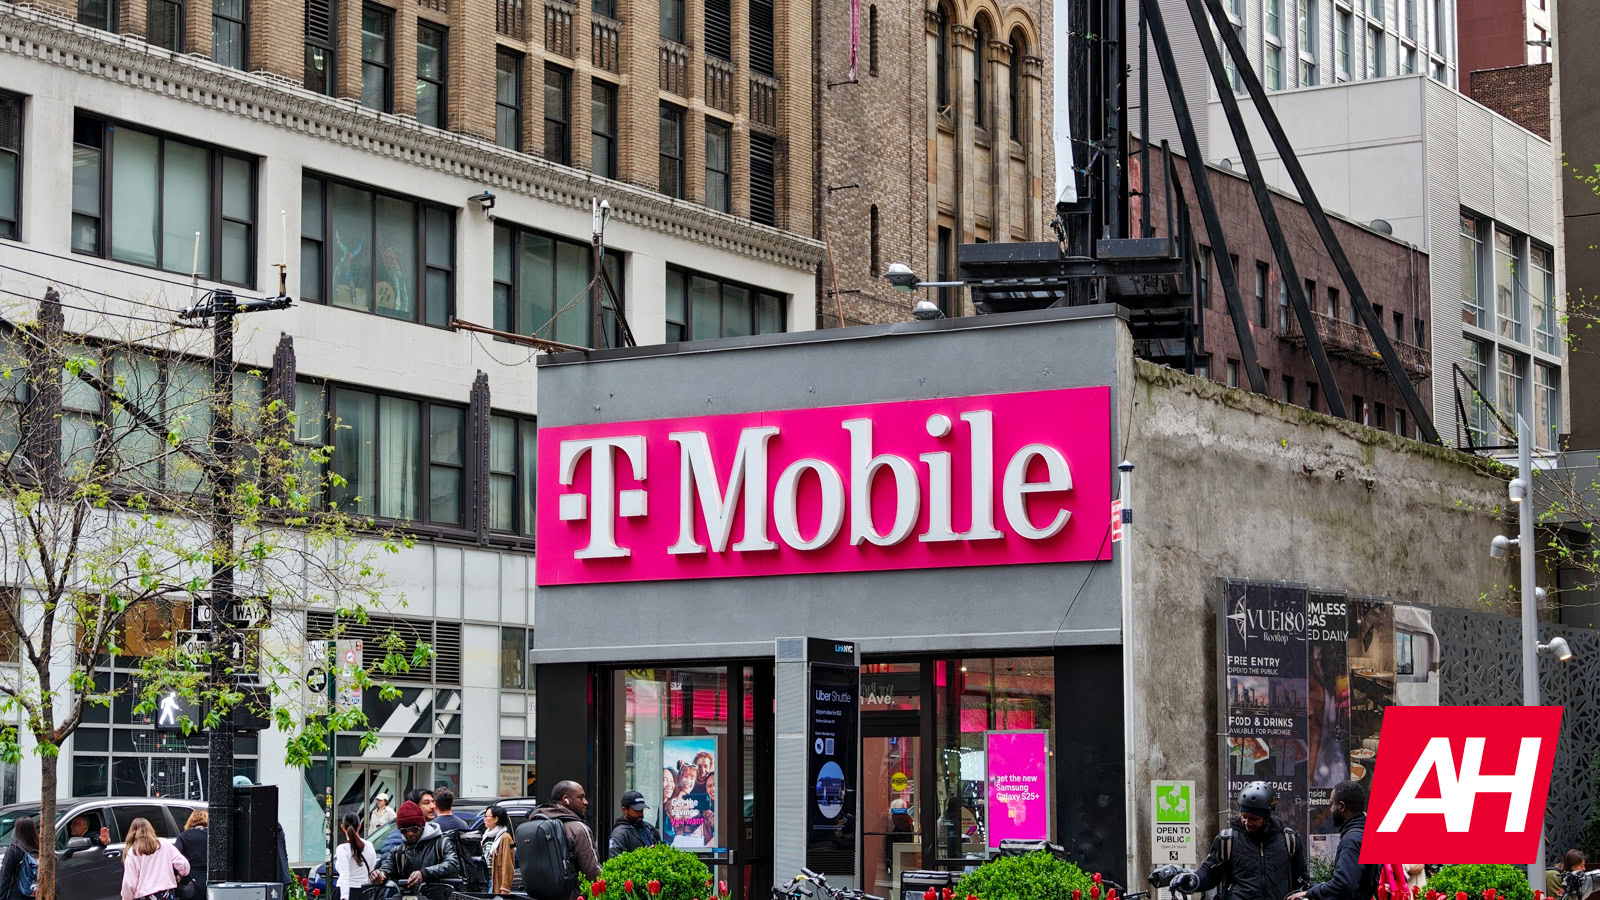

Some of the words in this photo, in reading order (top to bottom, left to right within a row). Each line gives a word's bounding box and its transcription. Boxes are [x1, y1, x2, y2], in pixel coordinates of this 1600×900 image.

[667, 409, 1073, 555] Mobile
[236, 604, 260, 620] WAY
[1263, 632, 1289, 645] Rooftop
[1322, 630, 1349, 642] DAILY
[187, 642, 206, 655] ONE
[834, 644, 854, 653] LinkNYC
[1227, 656, 1248, 666] FREE
[1251, 657, 1280, 667] ENTRY
[815, 689, 832, 701] Uber
[831, 691, 852, 703] Shuttle
[867, 692, 895, 704] Ave.
[1228, 716, 1252, 726] FOOD
[1254, 717, 1261, 726] &
[1263, 718, 1294, 728] DRINKS
[996, 775, 1008, 783] get
[1009, 774, 1021, 782] the
[996, 784, 1029, 792] Samsung
[1228, 781, 1250, 791] INDO
[996, 792, 1020, 801] Galaxy
[671, 798, 685, 806] Get
[686, 798, 698, 806] the
[1309, 798, 1331, 806] Restau
[671, 808, 699, 817] savings
[671, 818, 685, 826] you
